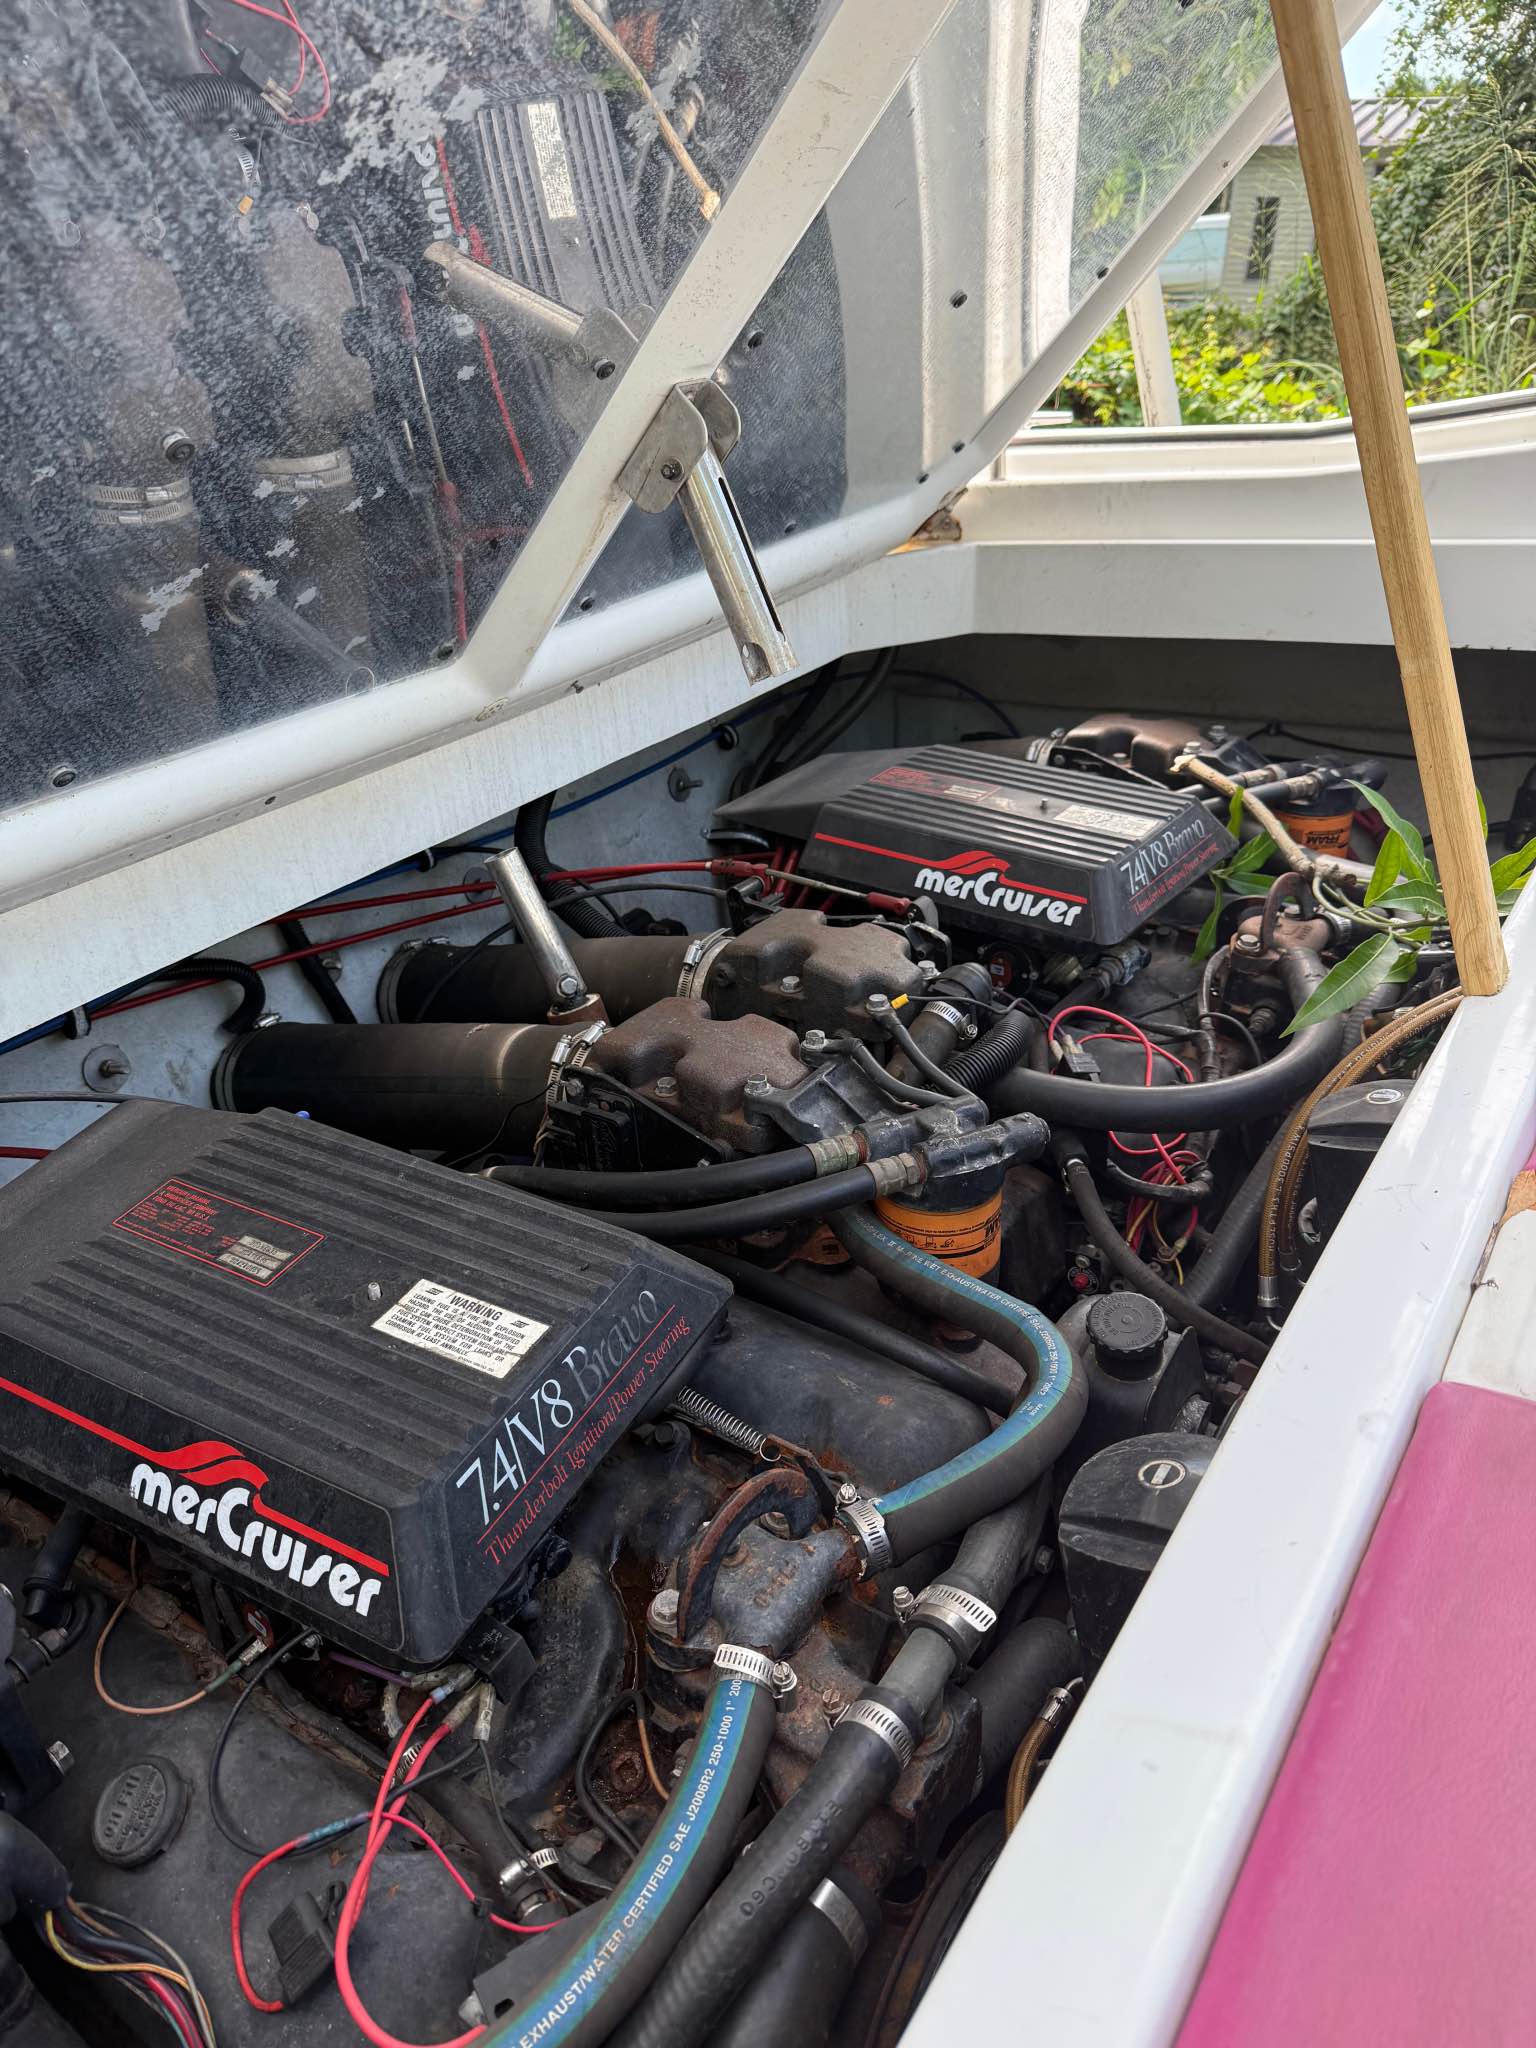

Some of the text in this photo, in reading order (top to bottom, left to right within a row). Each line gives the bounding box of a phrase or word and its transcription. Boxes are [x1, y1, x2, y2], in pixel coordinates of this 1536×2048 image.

[914, 868, 1082, 926] merCruiser
[396, 1308, 411, 1317] FUEL
[432, 1323, 456, 1335] INSPECT
[455, 1332, 478, 1344] SYSTEM
[402, 1303, 420, 1313] FUELS
[419, 1310, 432, 1318] CAN
[432, 1315, 451, 1325] CAUSE
[451, 1322, 493, 1342] DETERIORATION
[413, 1293, 436, 1304] LEAKING
[437, 1302, 451, 1310] FUEL
[467, 1313, 480, 1321] FIRE
[481, 1319, 494, 1327] AND
[495, 1324, 526, 1339] EXPLOSION
[449, 1295, 503, 1321] WARNING
[385, 1319, 416, 1334] CORROSION
[423, 1334, 441, 1344] LEAST
[390, 1314, 416, 1327] EXAMINE
[417, 1324, 433, 1333] FUEL
[434, 1331, 458, 1343] SYSTEM
[459, 1341, 472, 1349] FOR
[474, 1347, 493, 1357] LEAKS
[467, 1321, 492, 1334] ALCOHOL
[493, 1331, 520, 1345] MODIFIED
[562, 1290, 658, 1403] Bravo
[484, 1464, 570, 1566] Thunderbolt
[564, 1371, 648, 1471] Ignition/Power
[643, 1315, 692, 1375] Steering
[130, 1463, 381, 1617] merCruiser
[519, 1679, 742, 2048] EXHAUST/WATER CERTIFIED SAE J2006R2 250-1000 1" 200
